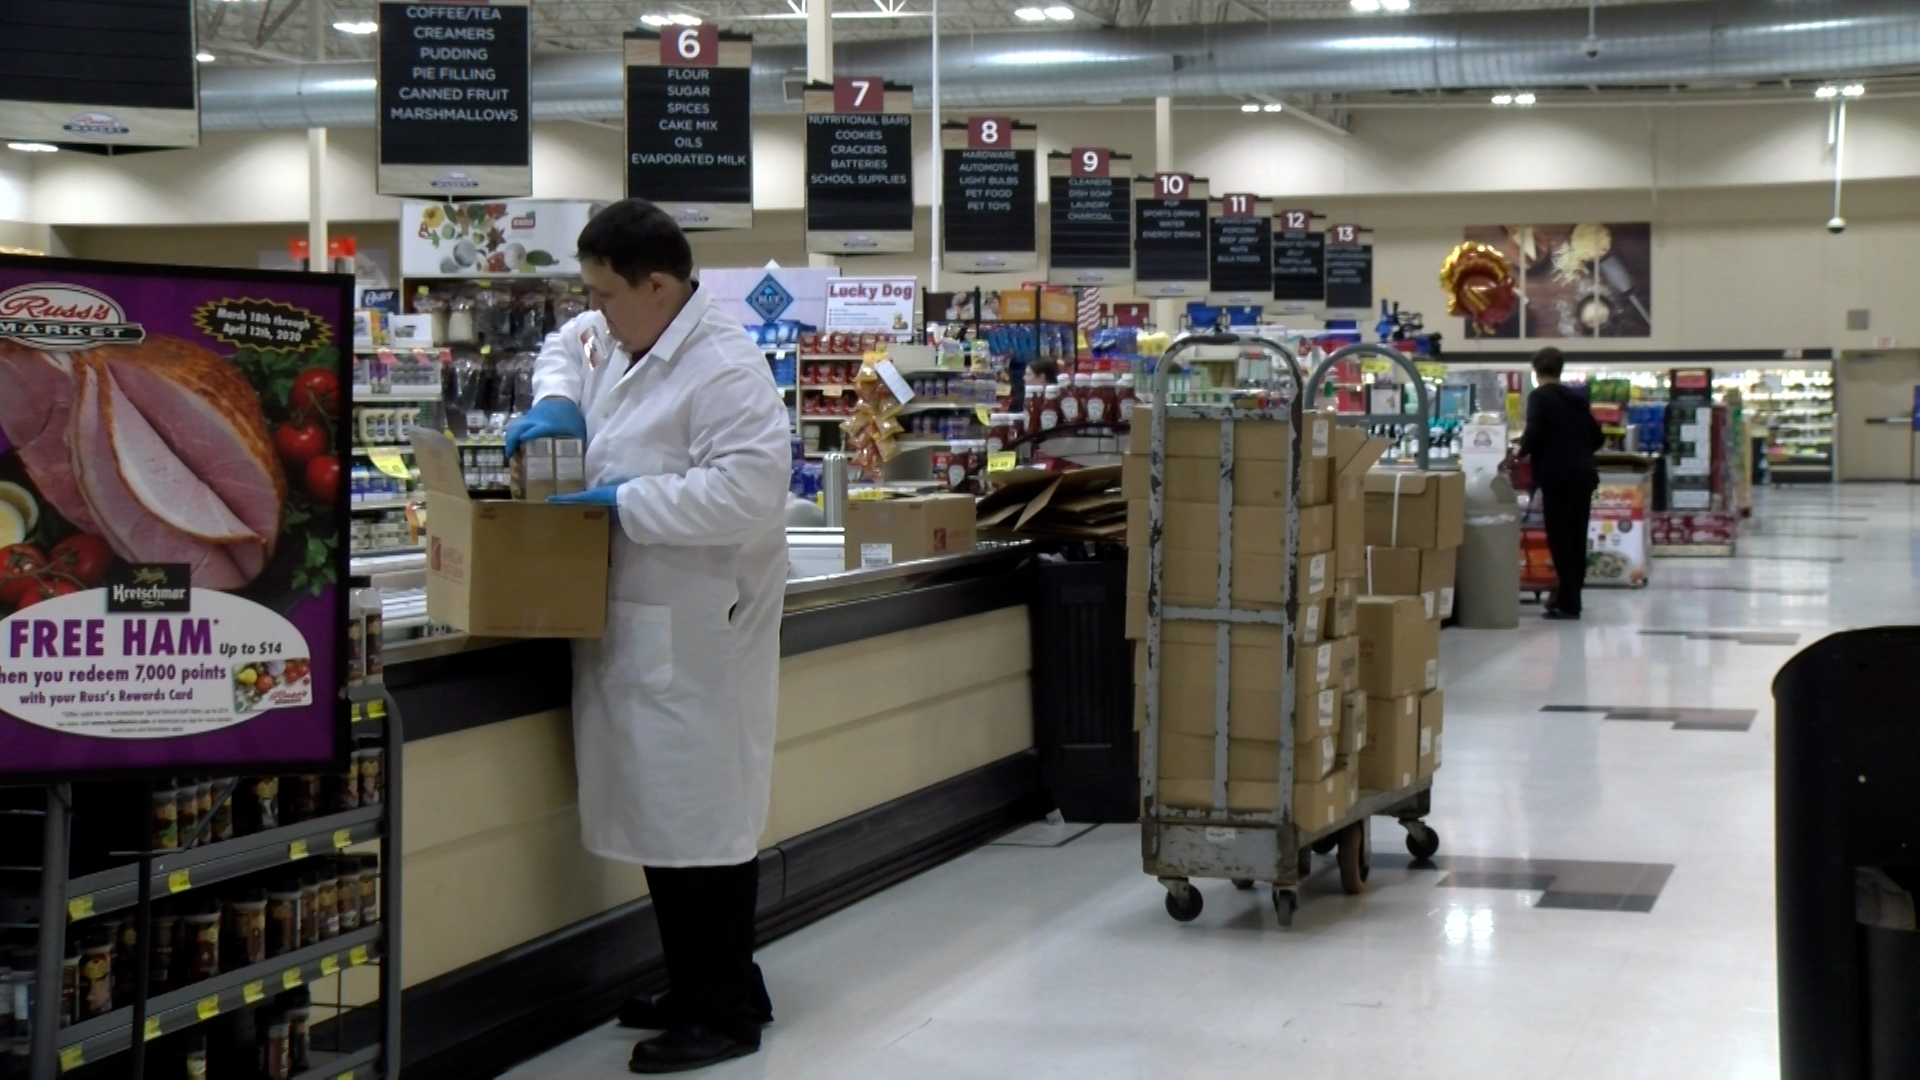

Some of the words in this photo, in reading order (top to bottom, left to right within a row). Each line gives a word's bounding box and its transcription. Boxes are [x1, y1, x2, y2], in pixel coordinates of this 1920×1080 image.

[405, 5, 502, 21] COFFEE/TEA
[412, 26, 496, 41] CREAMERS
[677, 29, 702, 59] 6
[419, 47, 489, 61] PUDDING
[412, 66, 437, 81] PIE
[439, 67, 497, 82] FILLING
[667, 69, 710, 80] FLOUR
[398, 86, 463, 101] CANNED
[466, 88, 510, 102] FRUIT
[667, 85, 711, 97] SUGAR
[851, 80, 870, 107] 7
[390, 107, 519, 122] MARSHMALLOWS
[667, 103, 710, 115] SPICES
[658, 119, 693, 131] CAKE
[696, 120, 718, 132] MIX
[808, 115, 879, 126] NUTRITIONAL
[881, 115, 910, 126] BARS
[835, 129, 883, 141] COOKIES
[980, 119, 999, 145] 8
[674, 137, 703, 148] OILS
[830, 145, 888, 155] CRACKERS
[631, 153, 715, 165] EVAPORATED
[717, 153, 747, 166] MILK
[962, 151, 1016, 160] HARDWARE
[1082, 150, 1099, 173] 9
[830, 159, 888, 170] BATTERIES
[958, 163, 1020, 172] AUTOMOTIVE
[810, 173, 855, 184] SCHOOL
[857, 173, 907, 185] SUPPLIES
[959, 176, 987, 186] LIGHT
[988, 176, 1019, 186] BULBS
[1159, 174, 1185, 196] 10
[965, 189, 983, 198] PET
[985, 189, 1013, 198] FOOD
[967, 202, 985, 211] PET
[987, 202, 1012, 211] TOYS
[1230, 194, 1247, 213] 11
[1286, 211, 1305, 229] 12
[1336, 225, 1354, 243] 13
[829, 284, 878, 300] Lucky
[882, 283, 913, 300] Dog
[0, 295, 111, 321] Russ's
[216, 307, 248, 322] March
[250, 311, 272, 325] 18th
[273, 315, 311, 332] through
[222, 322, 248, 336] April
[249, 325, 274, 341] 12th,
[276, 329, 302, 343] 2020
[112, 583, 187, 608] Kretschmar
[9, 618, 105, 659] FREE
[219, 643, 237, 658] Up
[241, 643, 256, 655] to
[259, 641, 283, 655] $14
[34, 670, 63, 688] you
[68, 663, 129, 682] redeem
[134, 663, 177, 684] 7,000
[181, 662, 227, 684] points
[19, 691, 46, 705] with
[49, 692, 77, 707] your
[80, 689, 116, 703] Russ's
[118, 688, 166, 703] Rewards
[168, 687, 194, 701] Card
